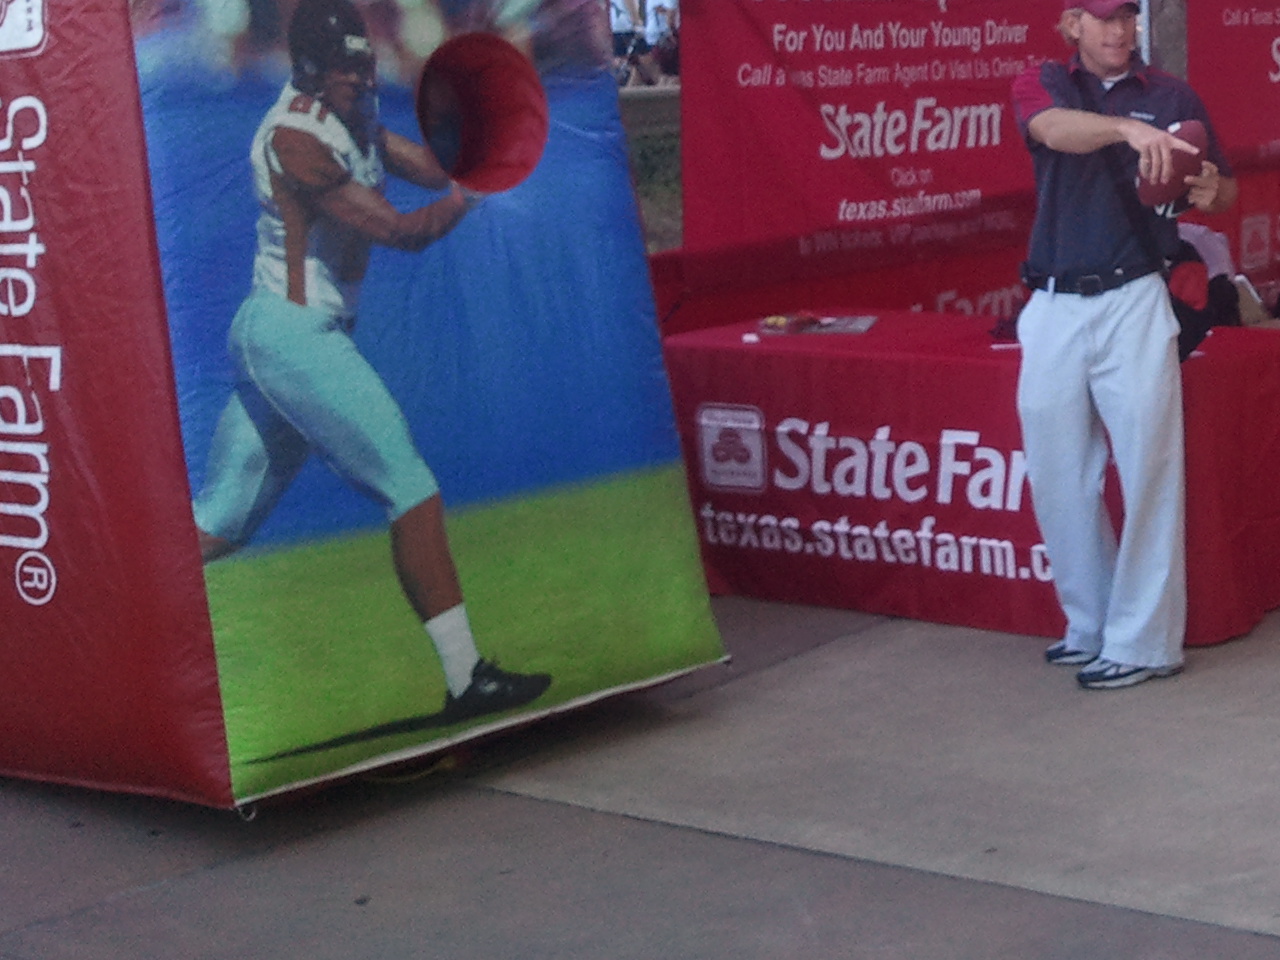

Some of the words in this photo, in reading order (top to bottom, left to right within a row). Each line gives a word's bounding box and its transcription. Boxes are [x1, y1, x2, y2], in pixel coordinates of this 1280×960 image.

[773, 23, 807, 51] For
[812, 23, 846, 51] You
[850, 23, 884, 50] And
[888, 21, 928, 48] Your
[931, 21, 981, 53] Young
[985, 19, 1029, 45] Driver
[738, 63, 772, 86] Call
[775, 68, 786, 86] a
[818, 65, 852, 87] State
[856, 63, 890, 85] Farm
[894, 60, 928, 87] Agent
[931, 59, 946, 81] Or
[773, 417, 930, 503] State
[936, 428, 1029, 513] Far
